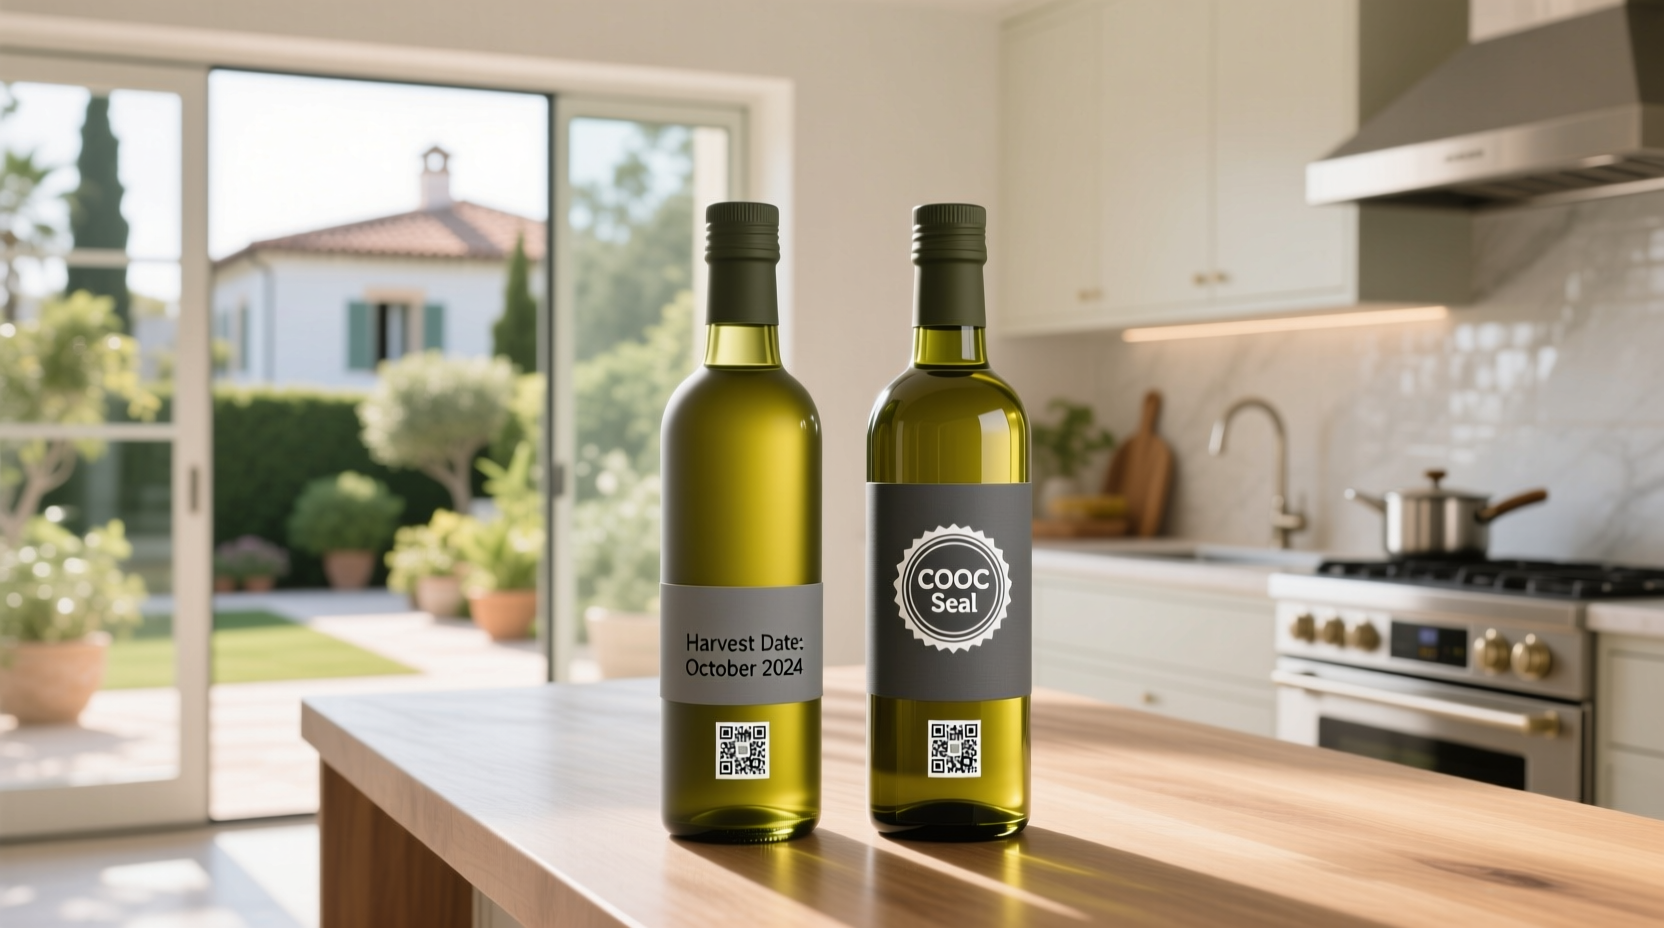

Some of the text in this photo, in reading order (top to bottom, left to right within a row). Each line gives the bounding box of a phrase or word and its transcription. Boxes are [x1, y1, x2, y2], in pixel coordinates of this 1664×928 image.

[917, 568, 990, 591] COOC
[931, 592, 978, 613] Seal
[685, 633, 804, 652] Harvest Date:
[685, 657, 804, 677] October 2024
